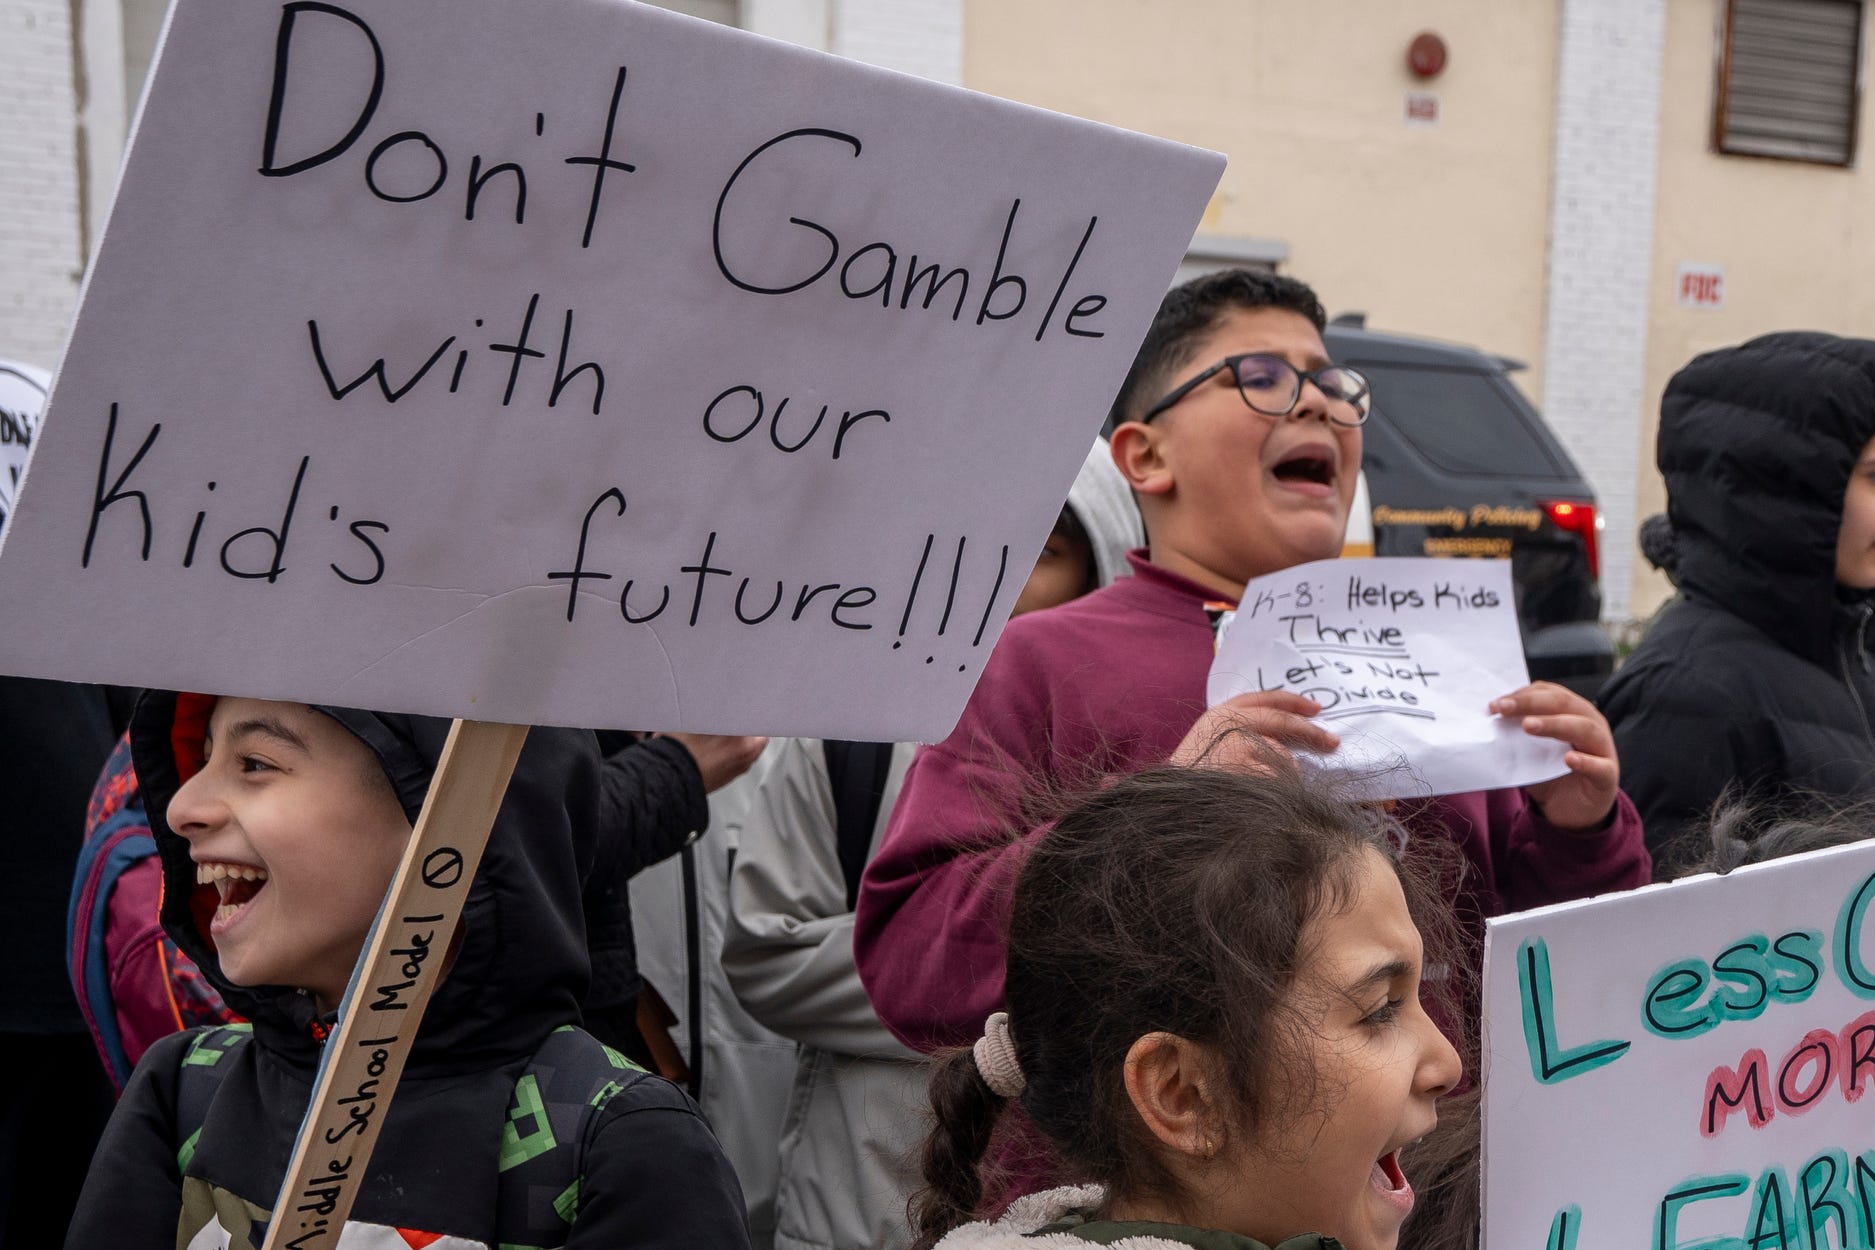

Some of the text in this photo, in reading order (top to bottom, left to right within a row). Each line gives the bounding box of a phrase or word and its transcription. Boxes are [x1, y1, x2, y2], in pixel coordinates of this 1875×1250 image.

[256, 1, 1108, 343] Don't Gamble
[307, 293, 892, 460] with our
[80, 401, 1010, 674] Kid's future!!!
[1347, 575, 1426, 613] Helps
[1433, 582, 1500, 610] Kids
[1257, 658, 1441, 693] Let's Not
[1278, 614, 1406, 648] Thrive
[1299, 685, 1420, 711] Divide
[326, 1035, 398, 1146] School
[369, 911, 446, 1012] Model
[1515, 926, 1826, 1084] Less
